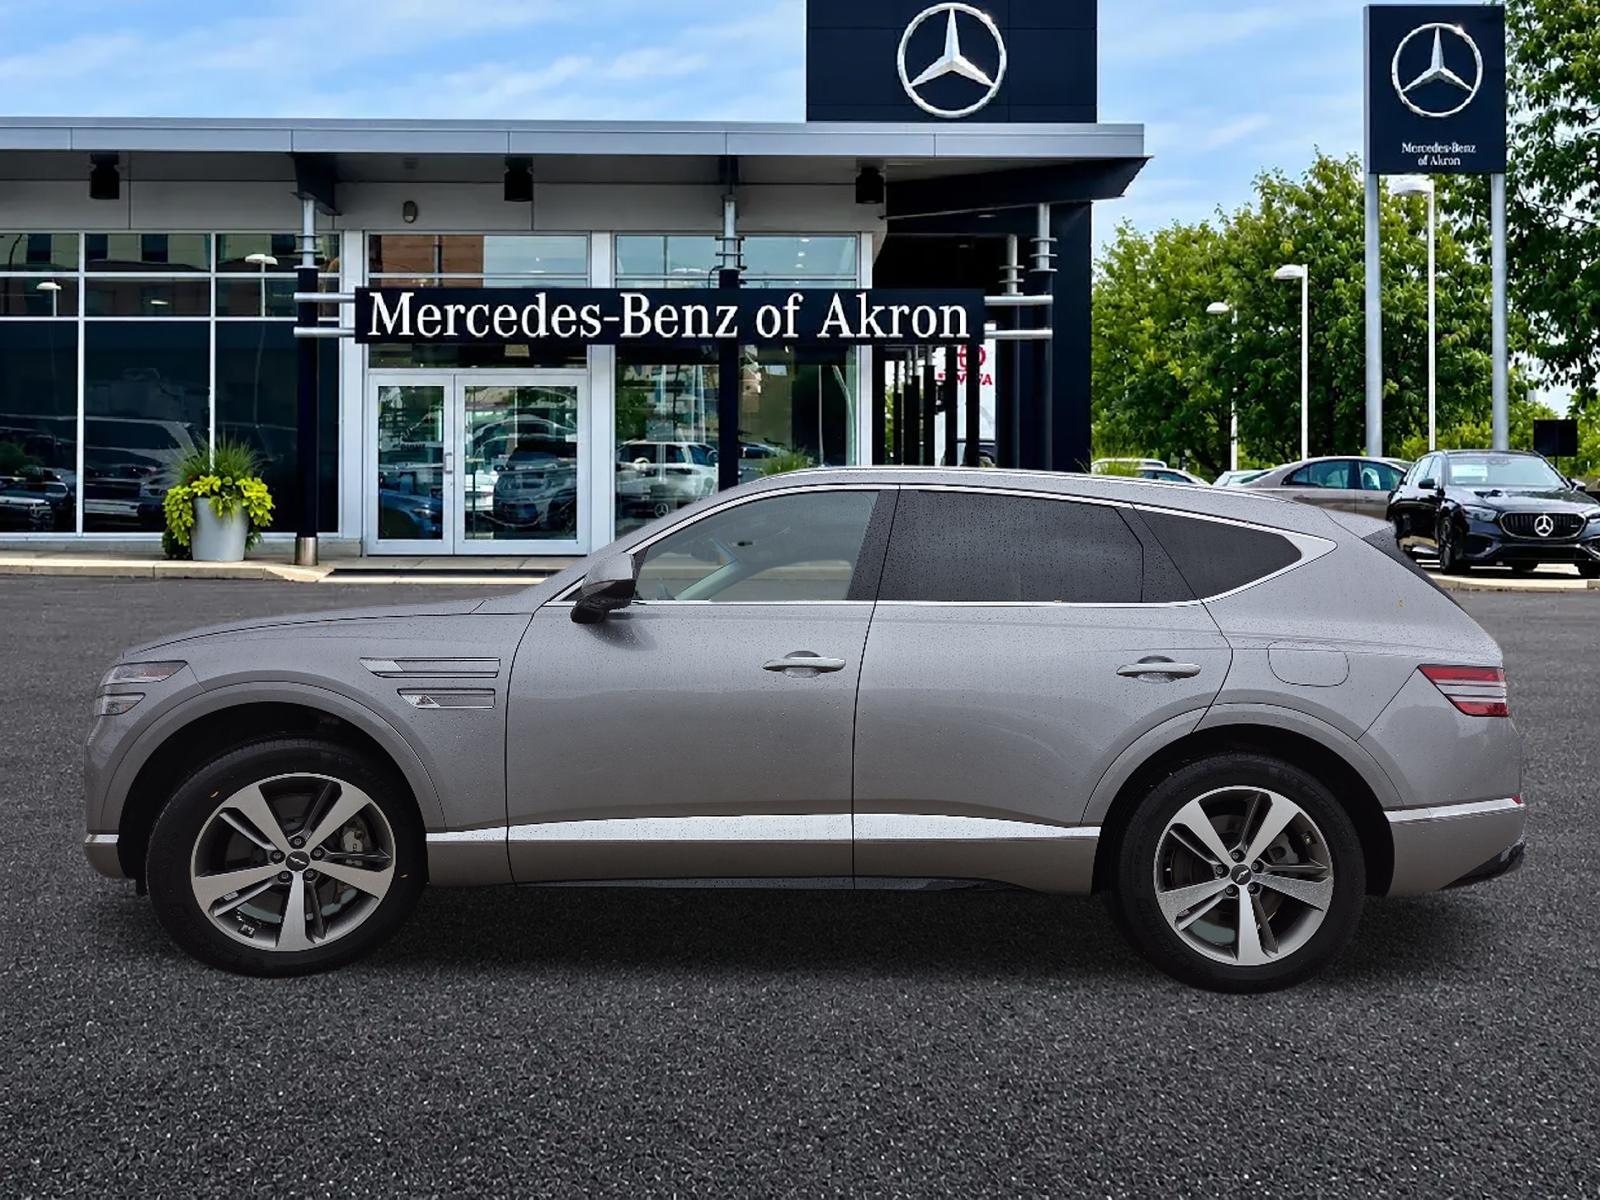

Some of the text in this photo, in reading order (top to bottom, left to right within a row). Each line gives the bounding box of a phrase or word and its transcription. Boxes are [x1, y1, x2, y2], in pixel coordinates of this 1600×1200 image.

[1401, 142, 1476, 154] Mercedes-Benz
[1417, 155, 1461, 166] of Akron
[368, 291, 971, 338] Mercedes-Benz of Akron
